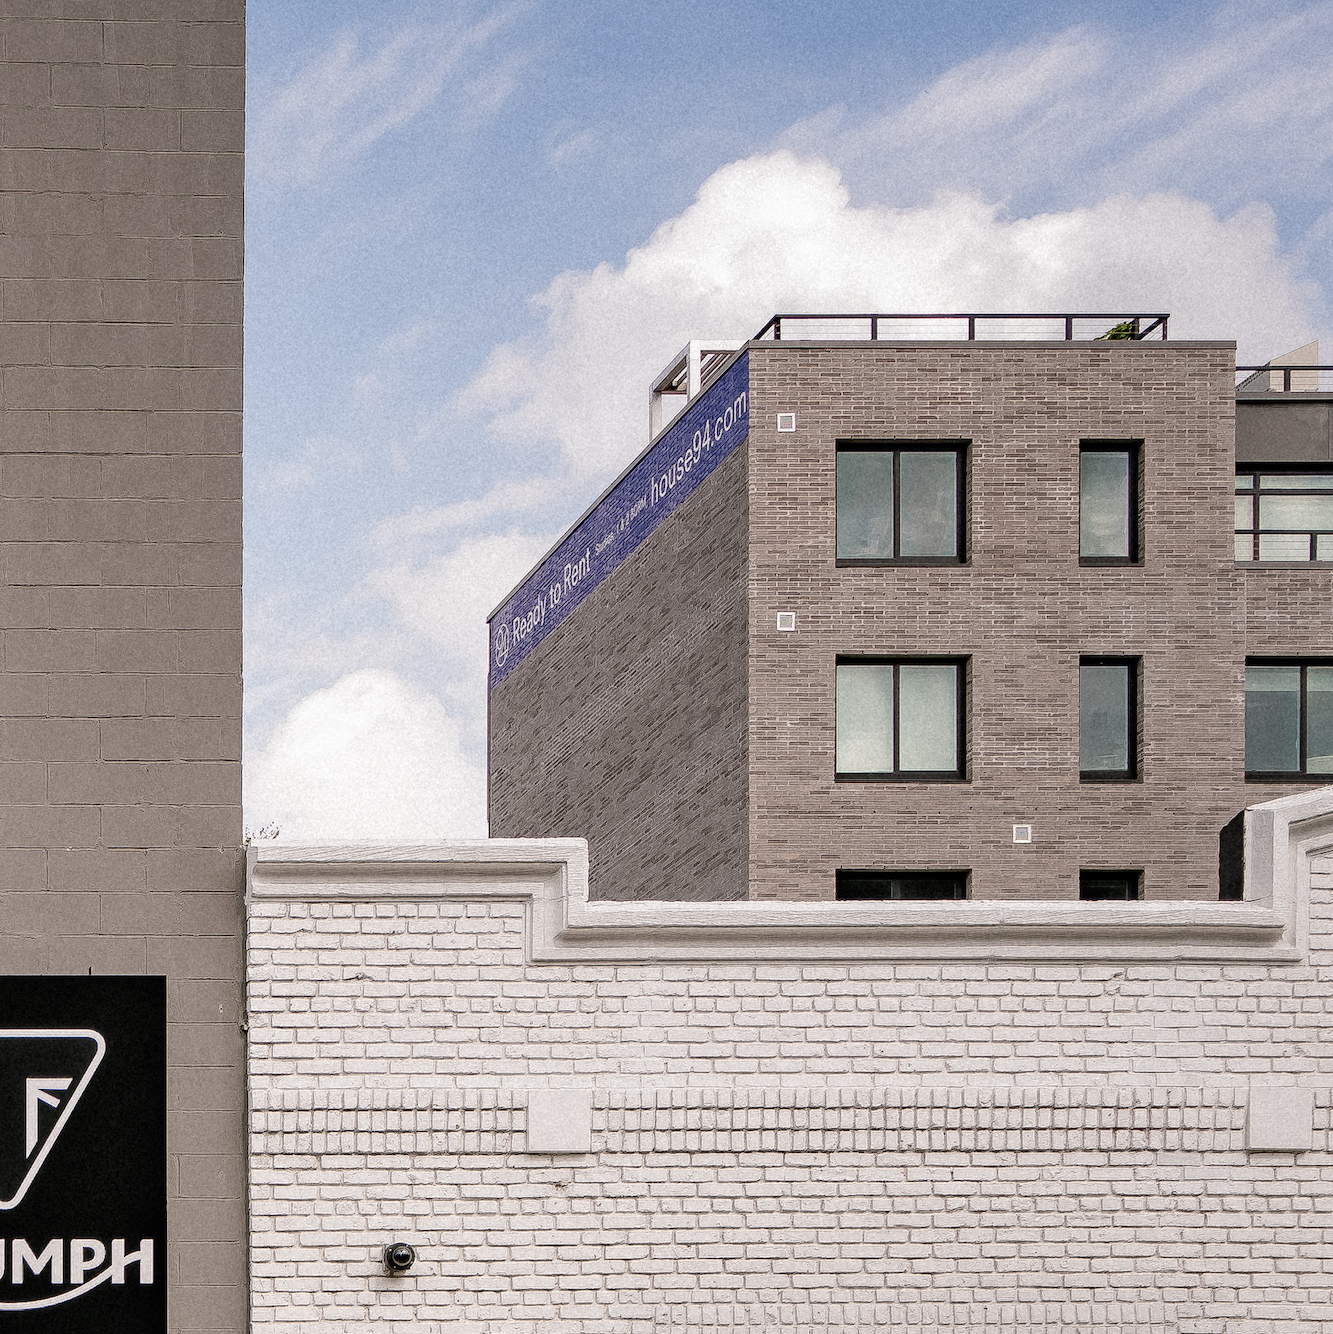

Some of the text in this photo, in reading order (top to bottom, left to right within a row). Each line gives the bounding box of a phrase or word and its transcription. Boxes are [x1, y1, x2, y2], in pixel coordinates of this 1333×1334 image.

[651, 391, 747, 506] house94.com
[513, 594, 547, 646] Ready
[549, 584, 561, 608] to
[564, 547, 590, 595] Rent
